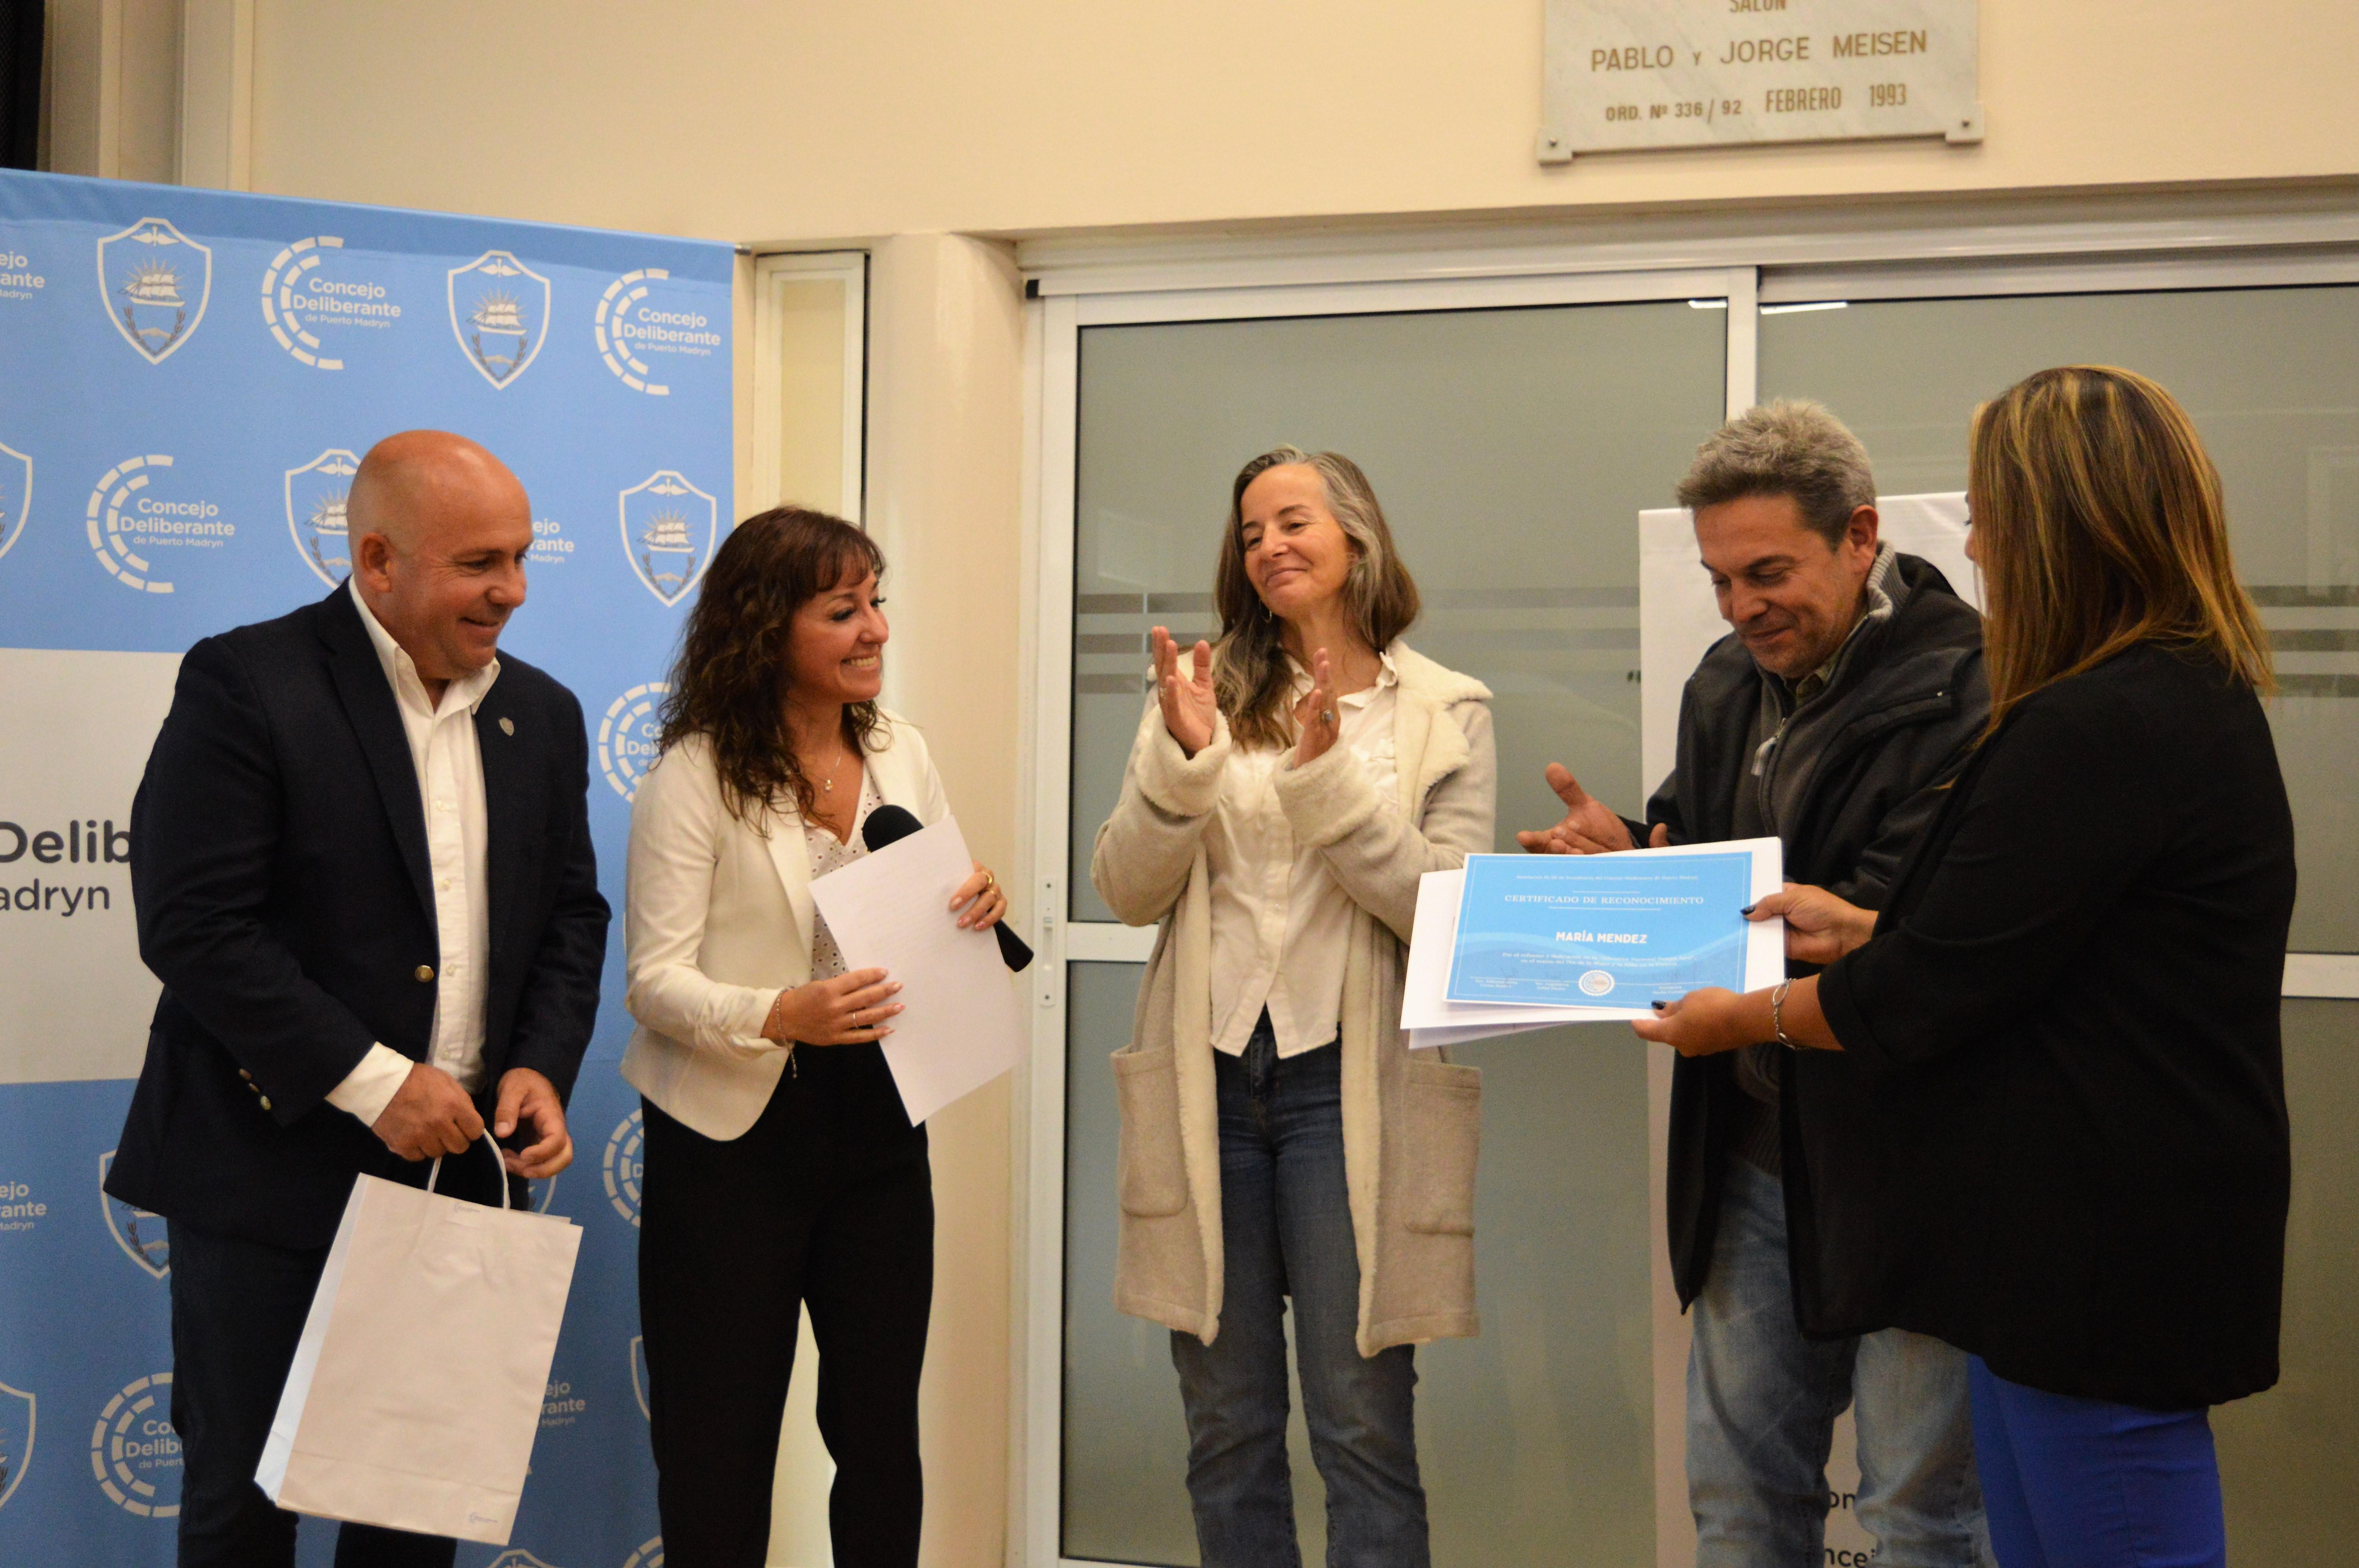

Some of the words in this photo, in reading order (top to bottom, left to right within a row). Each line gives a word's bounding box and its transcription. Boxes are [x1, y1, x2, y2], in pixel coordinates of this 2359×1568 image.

[1591, 45, 1674, 72] PABLO
[1721, 37, 1810, 64] JORGE
[1833, 30, 1926, 58] MEISEN
[1606, 105, 1642, 121] ORD.
[1766, 87, 1841, 113] FEBRERO
[1869, 83, 1906, 107] 1993
[309, 278, 386, 299] Concejo
[294, 295, 401, 317] Deliberante
[320, 315, 352, 325] Puerto
[355, 318, 390, 329] Madryn
[638, 307, 707, 328] Concejo
[624, 324, 721, 345] Deliberante
[648, 343, 677, 352] Puerto
[679, 346, 711, 356] Madryn
[138, 498, 218, 519] Concejo
[121, 516, 235, 536] Deliberante
[149, 536, 183, 546] Puerto
[186, 538, 224, 548] Madryn
[531, 554, 565, 564] Madryn
[0, 878, 110, 916] adryn
[1505, 895, 1579, 903] CERTIFICADO
[1556, 930, 1594, 942] MARÍA
[1597, 933, 1647, 943] MENDEZ
[155, 1458, 184, 1468] Puert
